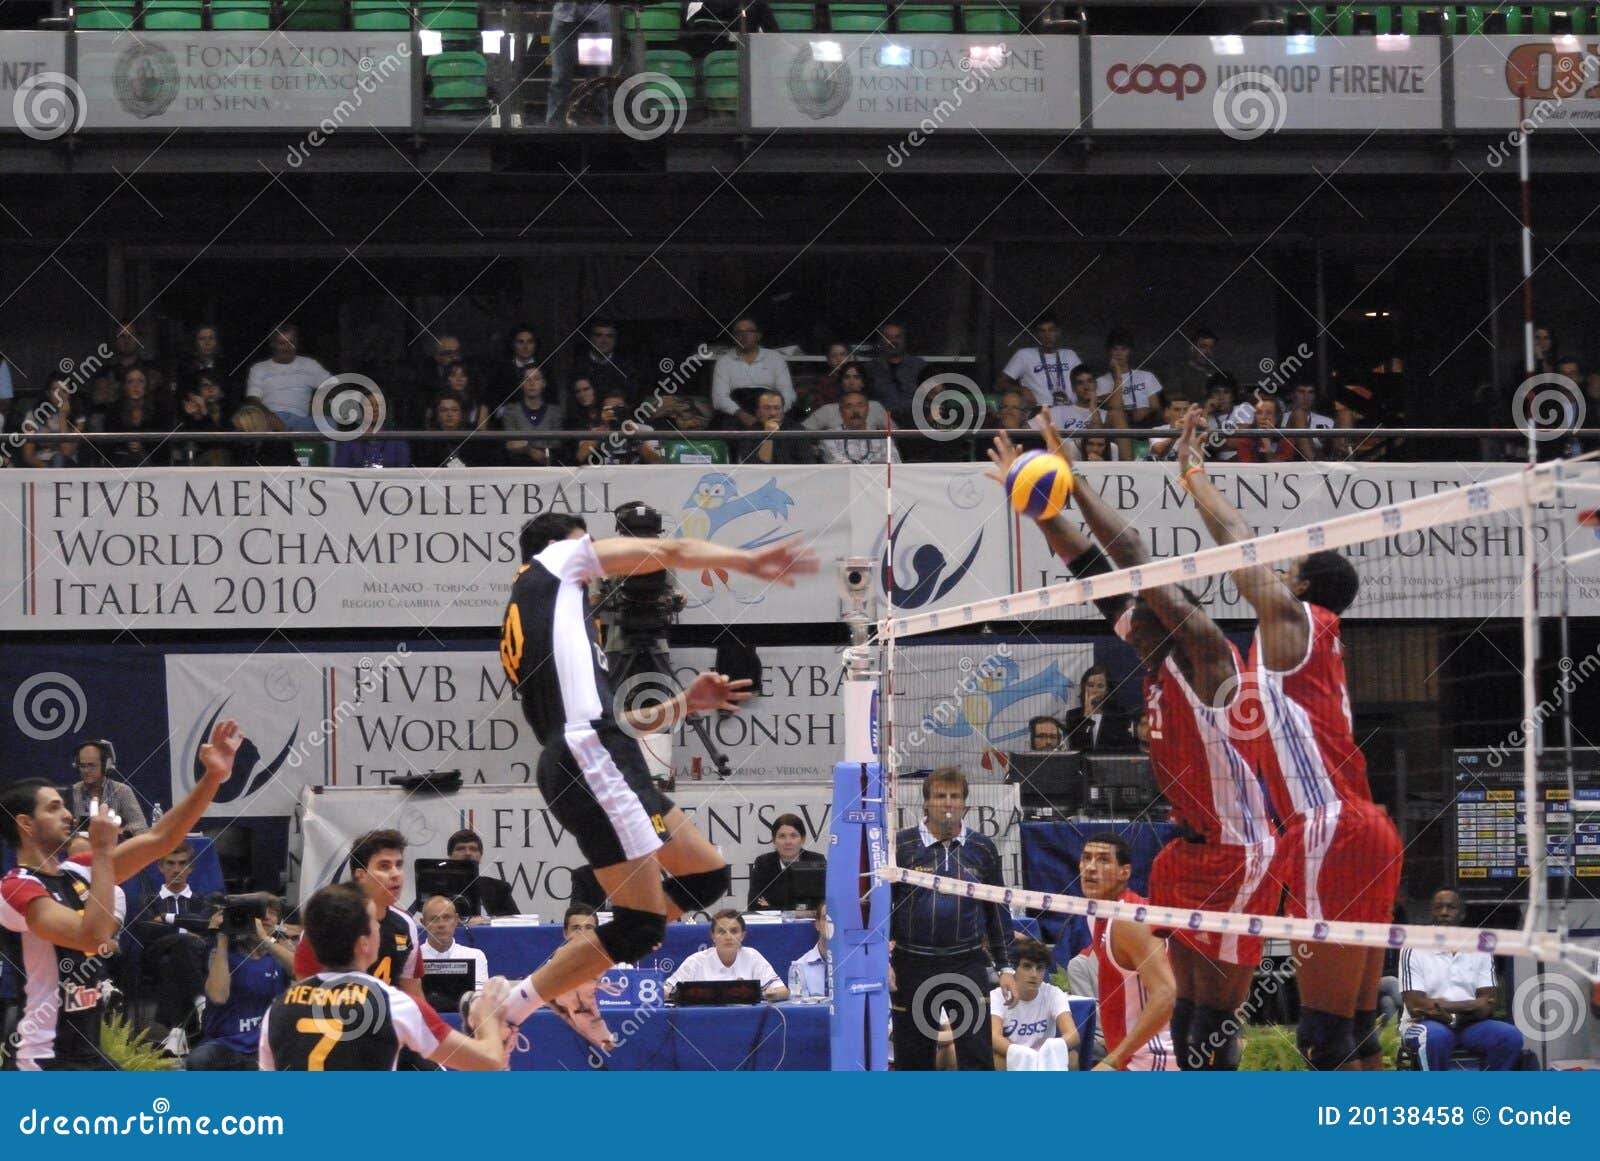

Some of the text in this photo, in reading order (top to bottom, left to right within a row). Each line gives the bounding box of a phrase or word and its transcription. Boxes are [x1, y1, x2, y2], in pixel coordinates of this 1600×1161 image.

[185, 45, 377, 68] FONDAZIONE
[186, 74, 262, 90] MONTE
[859, 76, 933, 92] MONTE
[1106, 63, 1207, 101] coop
[1217, 65, 1425, 94] UNICOOP FIRENZE
[213, 95, 270, 111] SIENA
[53, 479, 616, 518] FIVB MEN'S VOLLEYBALL
[53, 527, 515, 567] WORLD CHAMPIONS
[53, 576, 318, 616] ITALIA 2010
[363, 582, 423, 593] MILANO
[434, 583, 479, 593] TORINO
[342, 599, 385, 609] REGGIO
[452, 599, 499, 608] ANCONA
[353, 664, 457, 703] FIVB
[353, 714, 520, 753] WORLD
[775, 765, 819, 777] VERONA
[492, 808, 568, 849] FIV
[638, 978, 658, 1004] 8
[296, 1017, 344, 1071] 7
